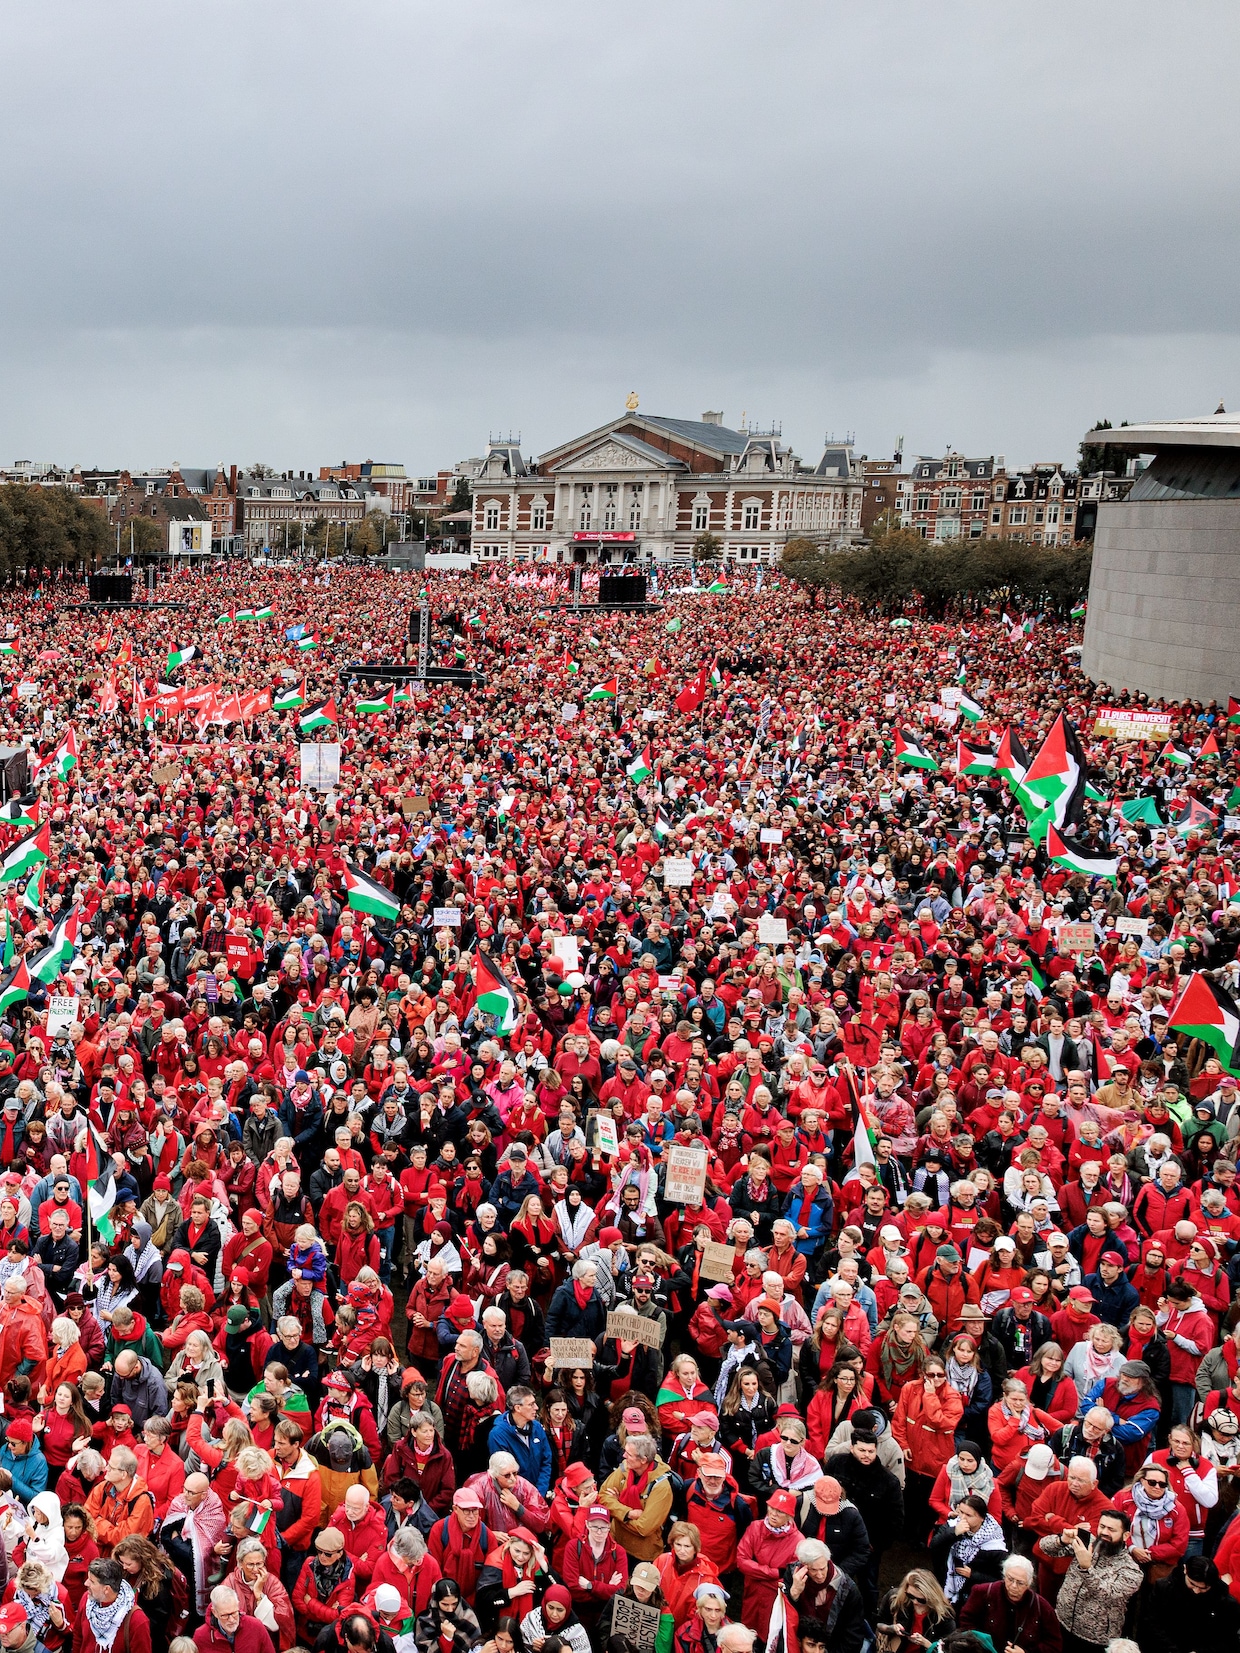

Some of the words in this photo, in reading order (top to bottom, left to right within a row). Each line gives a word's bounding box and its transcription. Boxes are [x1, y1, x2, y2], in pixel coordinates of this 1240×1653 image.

[1100, 710, 1132, 720] TILBURG
[1133, 712, 1172, 724] UNIVERSITY
[1060, 928, 1092, 938] FREE
[52, 998, 73, 1007] FREE
[50, 1008, 75, 1016] PALESTINE
[668, 1190, 682, 1200] WITTE
[708, 1246, 728, 1260] FREE
[608, 1314, 625, 1326] EVERY
[626, 1317, 641, 1330] CHILD
[642, 1320, 656, 1333] LOST
[612, 1328, 620, 1337] AN
[620, 1328, 639, 1340] ENTIRE
[641, 1334, 658, 1346] WORLD
[616, 1600, 632, 1622] STOP
[639, 1610, 658, 1650] ALESTINE
